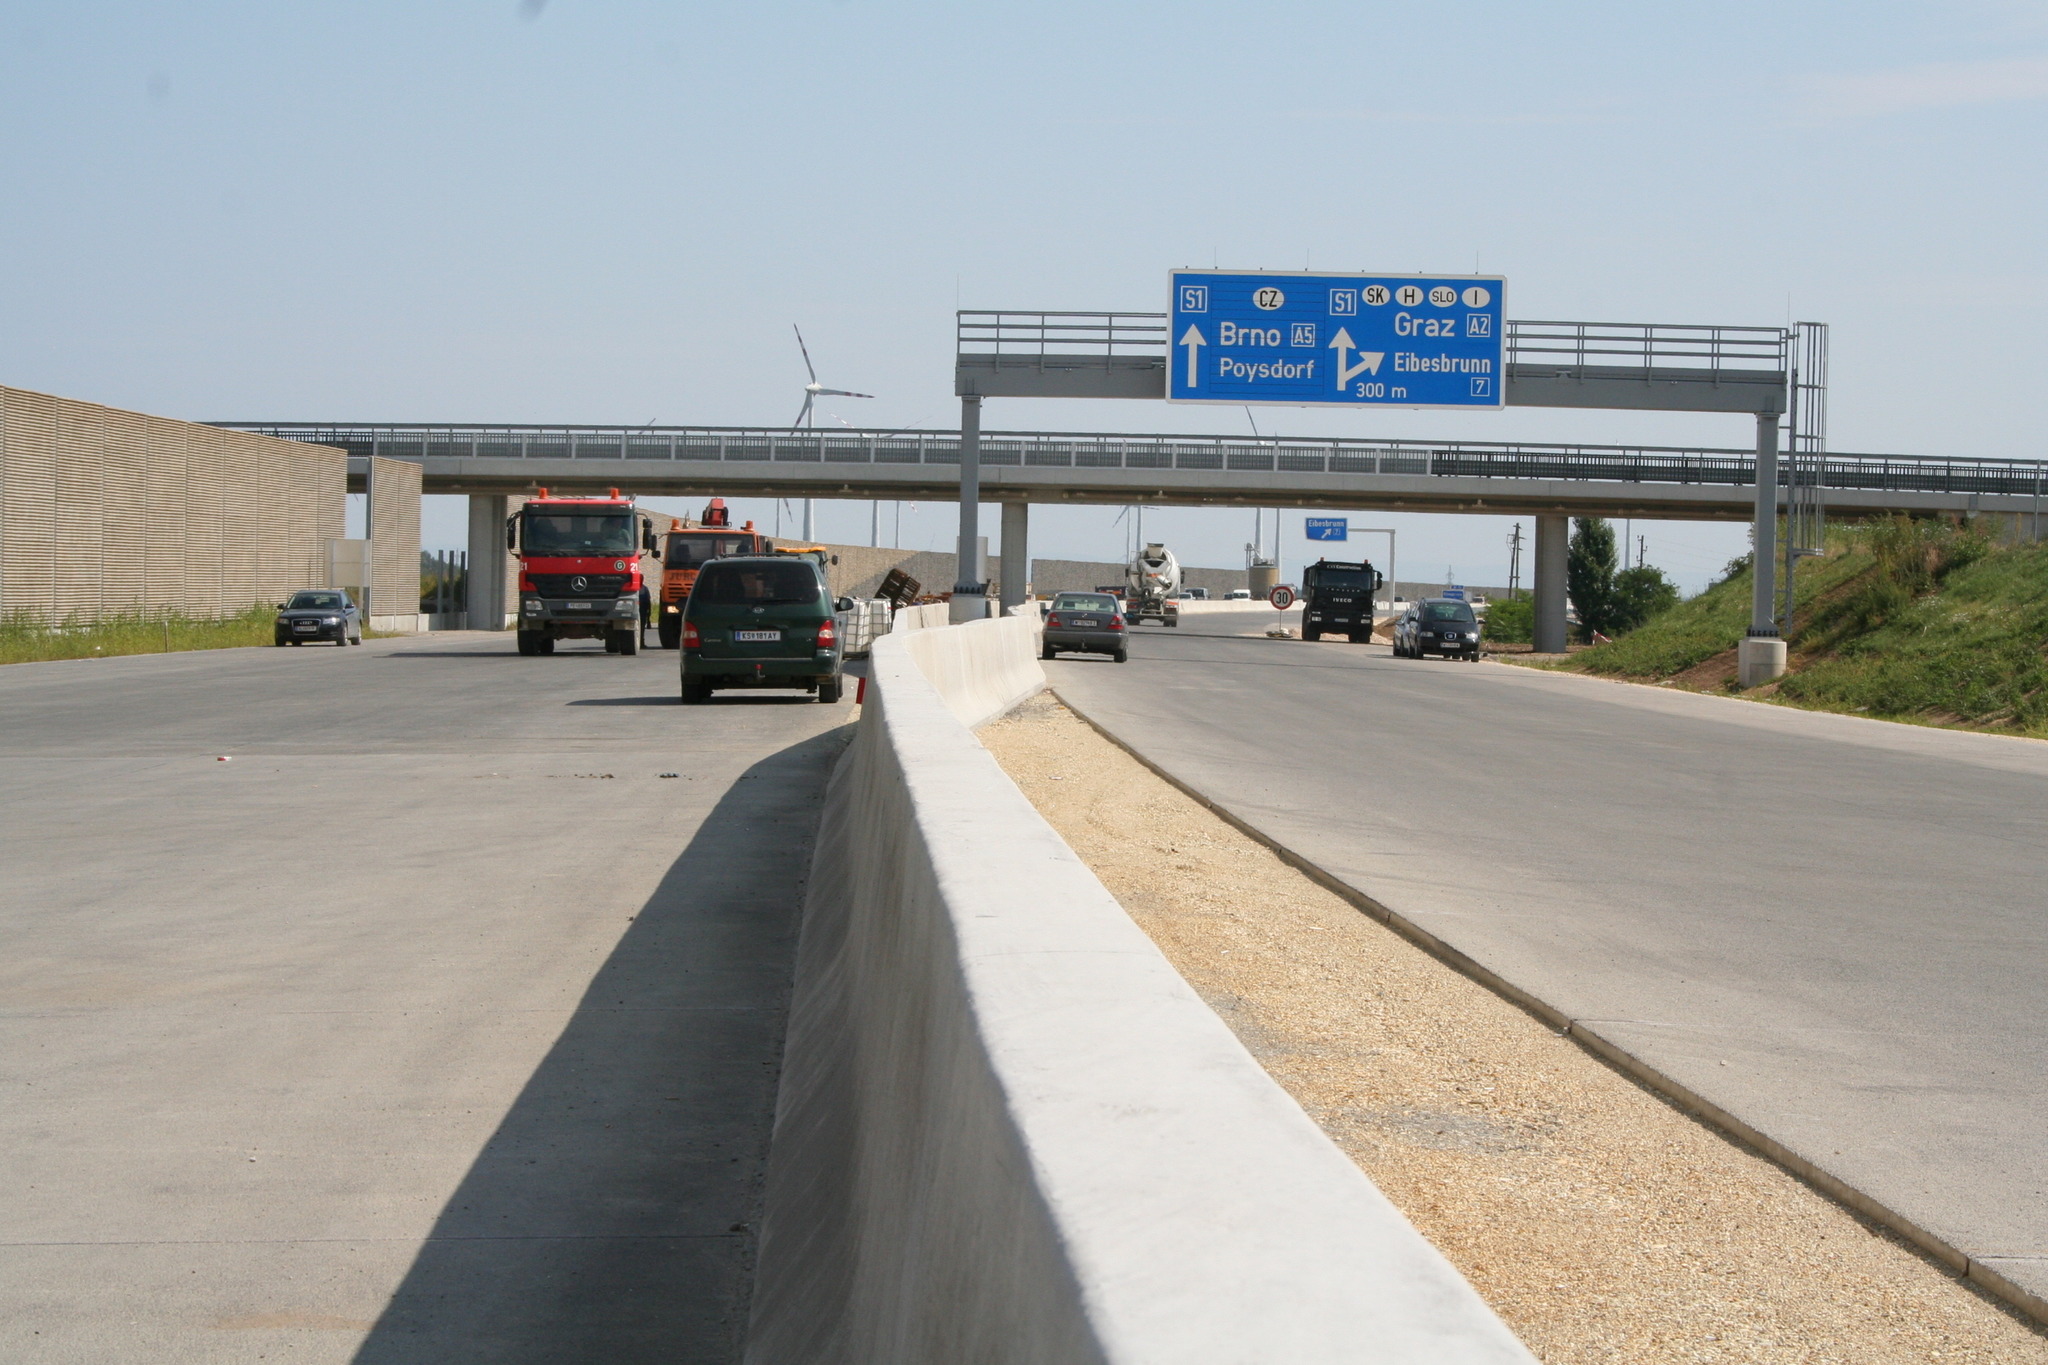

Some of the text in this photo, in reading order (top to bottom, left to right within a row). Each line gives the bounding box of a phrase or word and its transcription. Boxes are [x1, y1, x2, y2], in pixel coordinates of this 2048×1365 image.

[1185, 290, 1204, 309] S1
[1259, 290, 1278, 308] CZ
[1334, 292, 1353, 312] S1
[1366, 287, 1385, 304] SK
[1404, 289, 1415, 304] H
[1432, 290, 1453, 304] SLO
[1473, 290, 1478, 305] I
[1394, 312, 1456, 337] Graz
[1469, 317, 1488, 335] A2
[1220, 322, 1281, 347] Brno
[1294, 326, 1313, 344] A5
[1220, 357, 1315, 382] Poysdorf
[1394, 352, 1491, 374] Eibesbrunn
[1356, 382, 1407, 398] 300 m
[1476, 380, 1485, 394] 7
[1308, 519, 1344, 527] Eibesbrunn
[630, 562, 639, 571] 21
[1275, 591, 1288, 605] 30
[742, 632, 752, 640] KS
